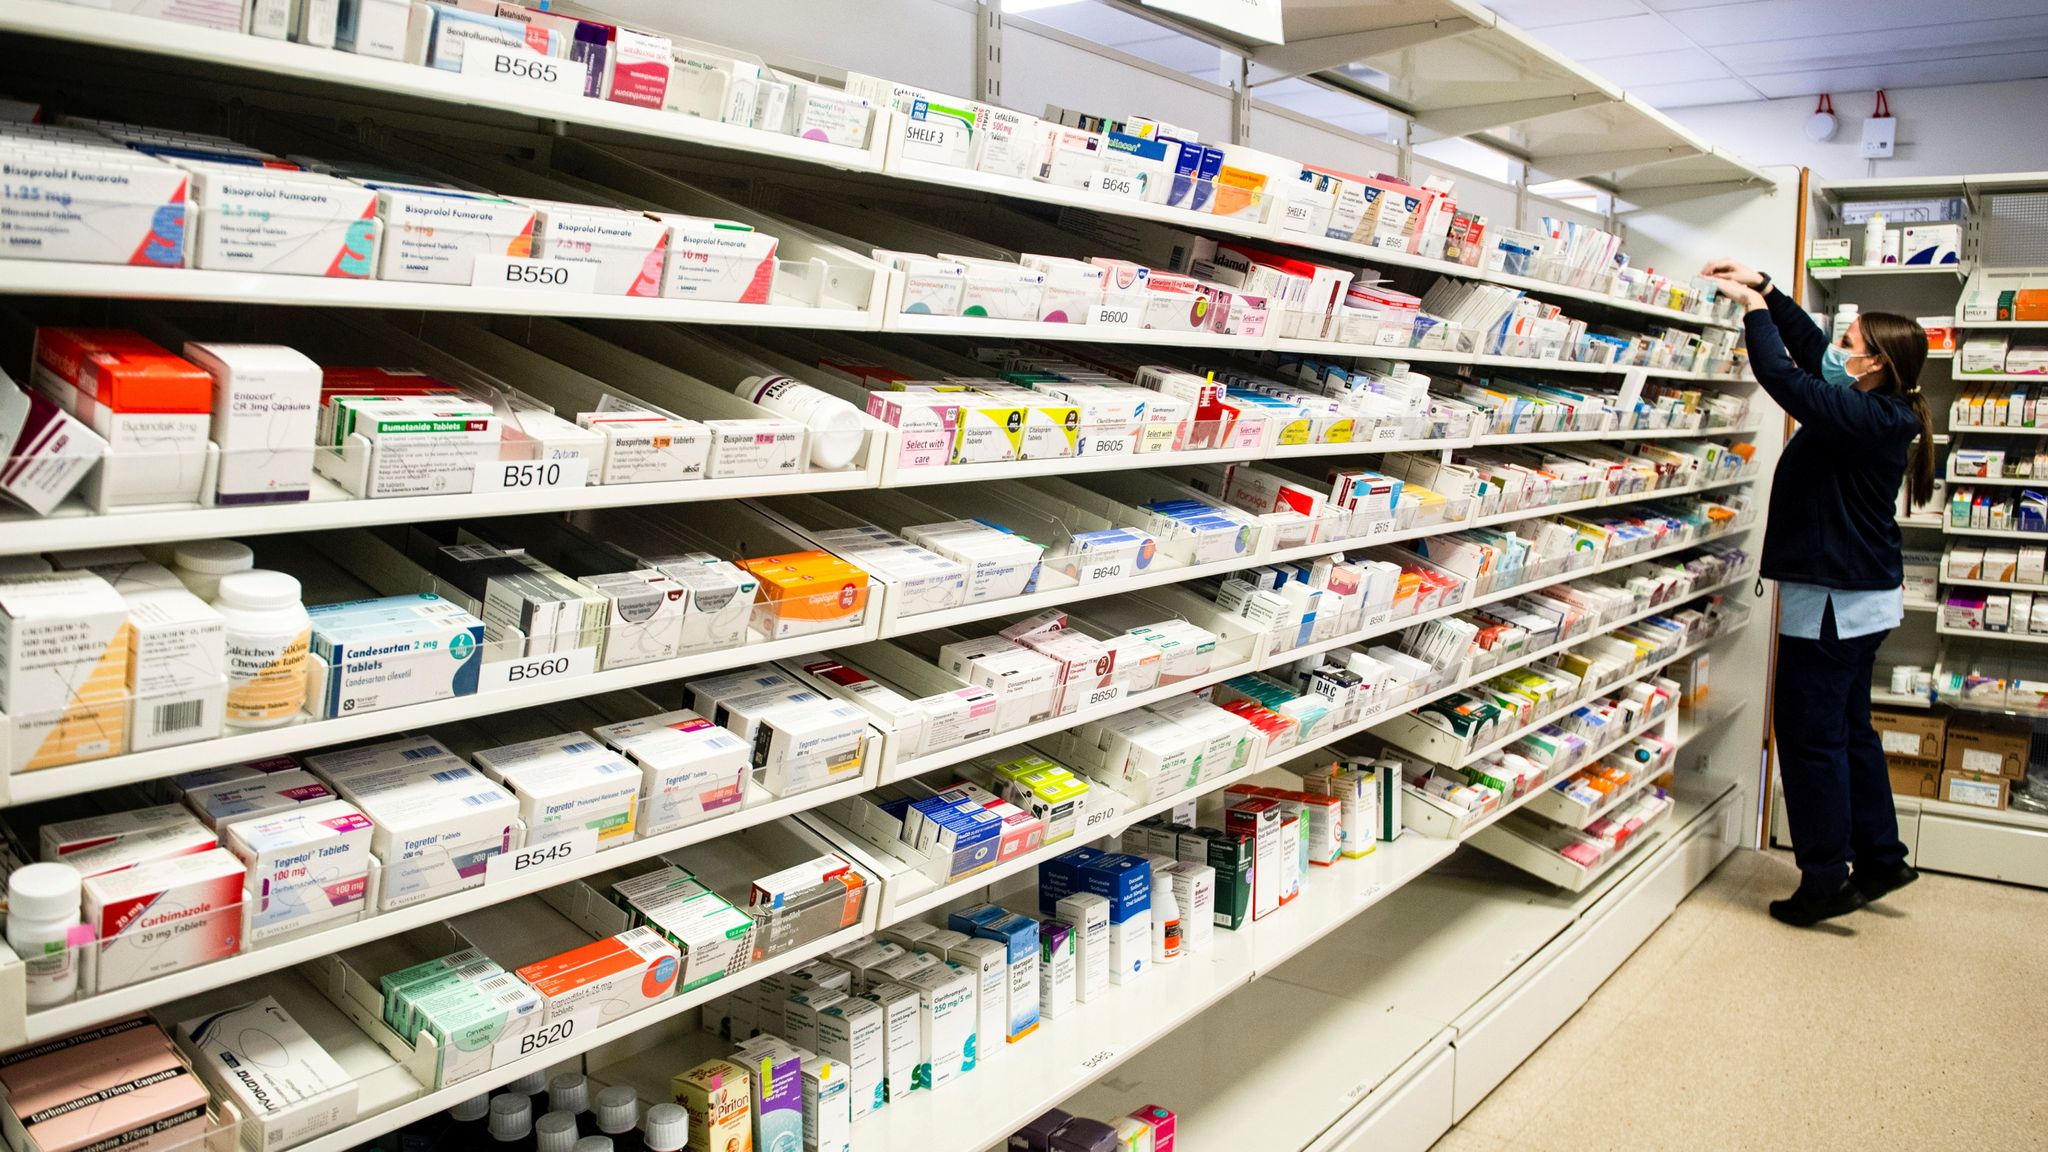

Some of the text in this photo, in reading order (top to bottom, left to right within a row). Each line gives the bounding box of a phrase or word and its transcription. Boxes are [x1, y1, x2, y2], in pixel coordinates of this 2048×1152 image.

[499, 7, 532, 23] Betahistine
[494, 54, 558, 83] B565
[906, 126, 944, 144] SHELF 3
[3, 164, 129, 186] Bisoprolol Fumarate
[3, 184, 41, 202] 1.25
[222, 184, 328, 204] Bisoprolol Fumarate
[1102, 178, 1131, 194] B645
[405, 204, 494, 223] Bisoprolol Fumarate
[1286, 205, 1302, 217] SHELF
[404, 220, 434, 238] 5 mg
[558, 221, 633, 239] Bisoprolol Fumarate
[575, 240, 592, 253] mg
[682, 235, 747, 250] Bisoprolol Fumarate
[682, 249, 709, 263] 10 mg
[506, 263, 569, 286] B550
[1099, 310, 1129, 324] B600
[233, 392, 273, 401] Entocort
[249, 403, 269, 413] 3mg
[270, 403, 311, 413] Capsules
[1010, 412, 1019, 421] 10
[381, 421, 486, 432] Bumetanide Tablets 1mg
[967, 428, 992, 439] Citalopram
[1028, 426, 1052, 435] Citalopram
[615, 436, 696, 448] Buspirone 5 mg tablets
[723, 433, 796, 445] Buspirone 10 mg tablets
[966, 437, 983, 446] Tablets
[1027, 434, 1043, 443] Tablets
[1146, 429, 1173, 441] Select with
[906, 438, 945, 451] Select with
[1095, 439, 1124, 452] B605
[914, 455, 931, 464] care
[503, 463, 561, 487] B510
[976, 566, 1015, 579] 25 microgram
[1093, 564, 1121, 580] B640
[843, 586, 854, 597] 25
[842, 596, 854, 606] mg
[458, 634, 466, 647] 2
[346, 639, 439, 659] Candesartan 2 mg
[230, 656, 280, 671] Chewable
[345, 660, 383, 674] Tablets
[508, 657, 570, 682] B560
[1090, 687, 1118, 705] B650
[1316, 680, 1337, 698] DHC
[798, 738, 819, 751] Tegretol
[665, 774, 691, 787] Tegretol
[545, 801, 575, 816] Tegretol
[602, 790, 619, 801] Release
[619, 787, 637, 797] Tablets
[332, 813, 369, 827] 100 mg
[602, 816, 626, 828] 200 mg
[1087, 807, 1114, 827] B610
[404, 831, 462, 851] Tegretol Tablets
[274, 841, 350, 869] Tegretol Tablets
[402, 849, 424, 860] 200 mg
[472, 853, 486, 863] 200
[514, 841, 572, 871] B545
[273, 866, 307, 882] 100 mg
[335, 881, 364, 895] 100 mg
[115, 901, 146, 929] 20 mg
[140, 902, 212, 929] Carbimazole
[140, 919, 209, 943] 20 mg Tablets
[550, 991, 586, 1010] Carvedilol
[933, 985, 968, 1005] Clarithromycin
[934, 991, 974, 1014] 250 ml
[550, 1005, 575, 1019] Tablets
[465, 1021, 495, 1039] Carvedilol
[520, 1019, 575, 1055] B520
[1, 1018, 145, 1066] Carbocisteine 375mg Capsules
[470, 1034, 491, 1046] Tablets
[30, 1068, 179, 1124] Carbocisteine 375mg Capsules
[717, 1093, 749, 1118] Piriton
[120, 1108, 199, 1143] 375mg Capsules
